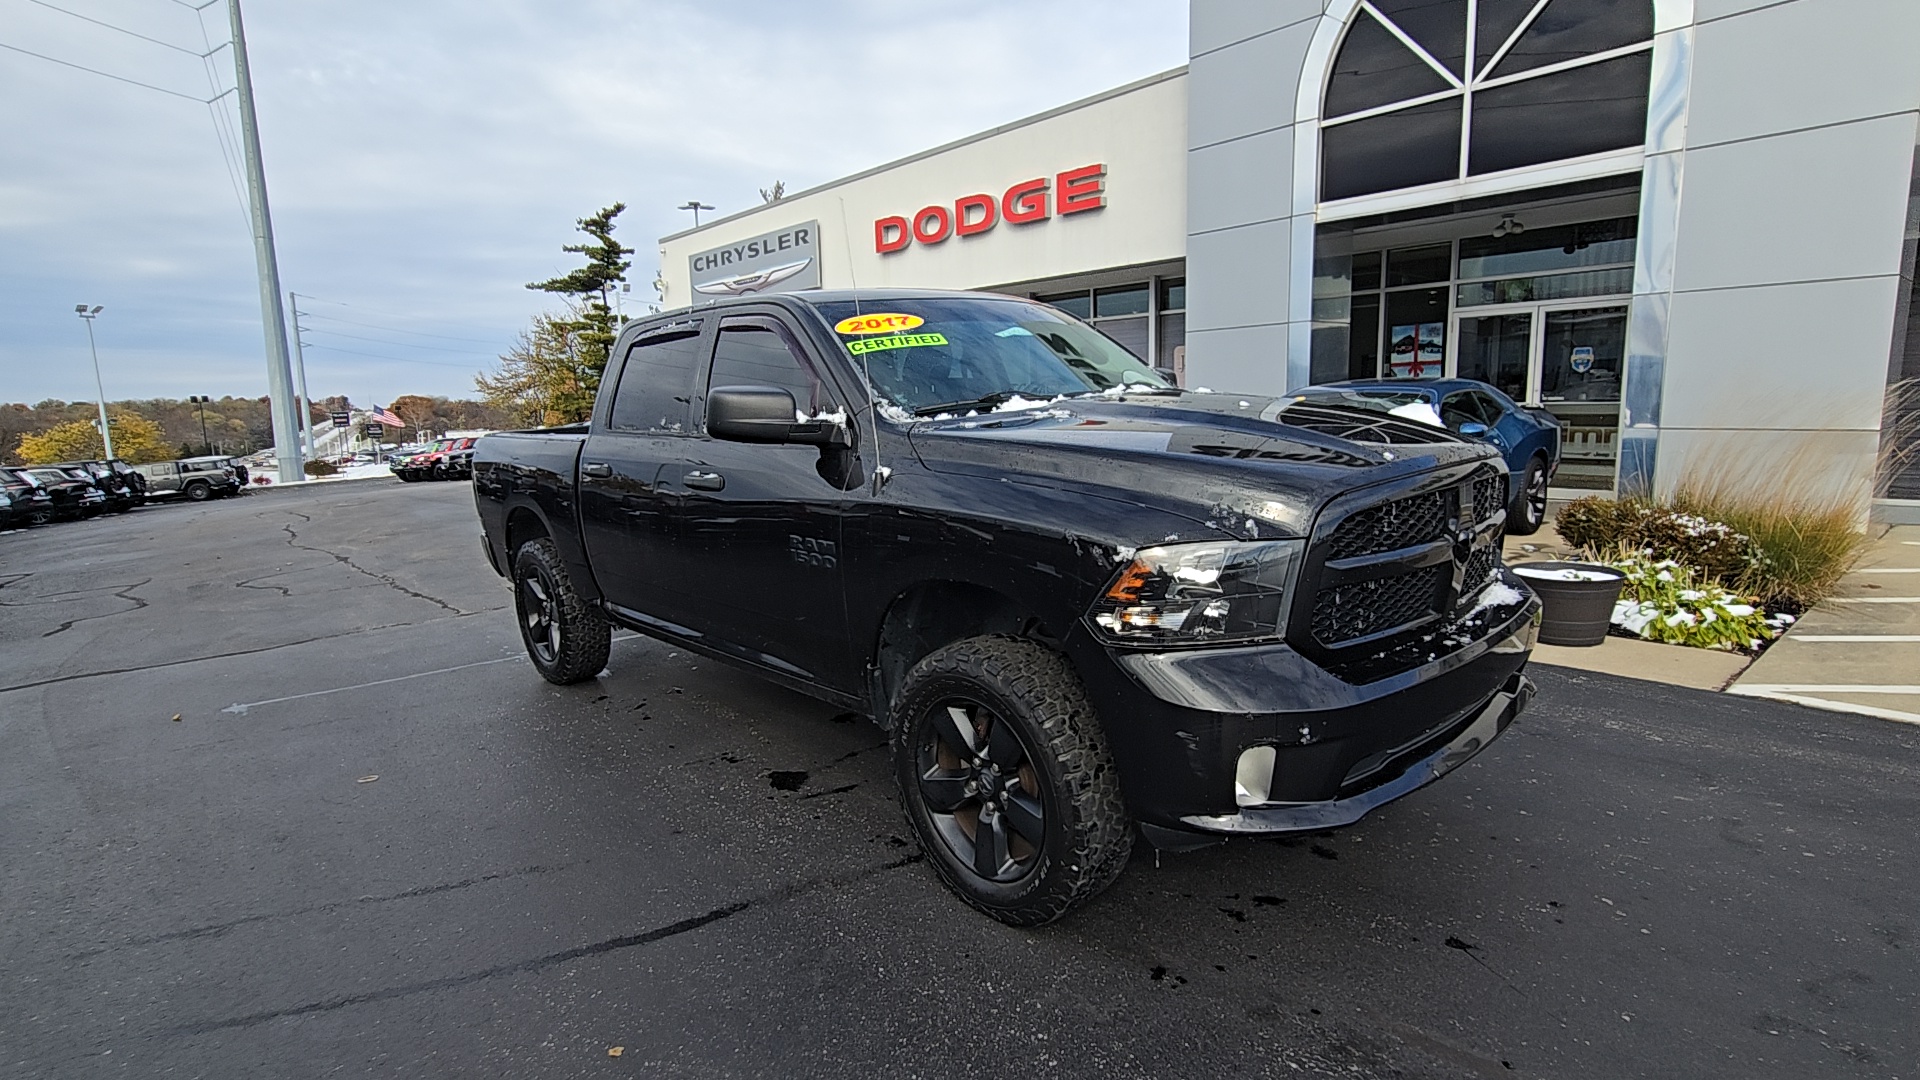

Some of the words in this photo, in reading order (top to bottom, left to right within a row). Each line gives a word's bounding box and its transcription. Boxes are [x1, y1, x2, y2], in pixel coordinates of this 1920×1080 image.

[875, 163, 1107, 254] DODGE
[693, 228, 810, 272] CHRYSLER
[848, 316, 909, 333] 2017
[851, 335, 941, 352] CERTIFIED
[789, 534, 836, 554] RAM
[790, 548, 837, 569] 1500
